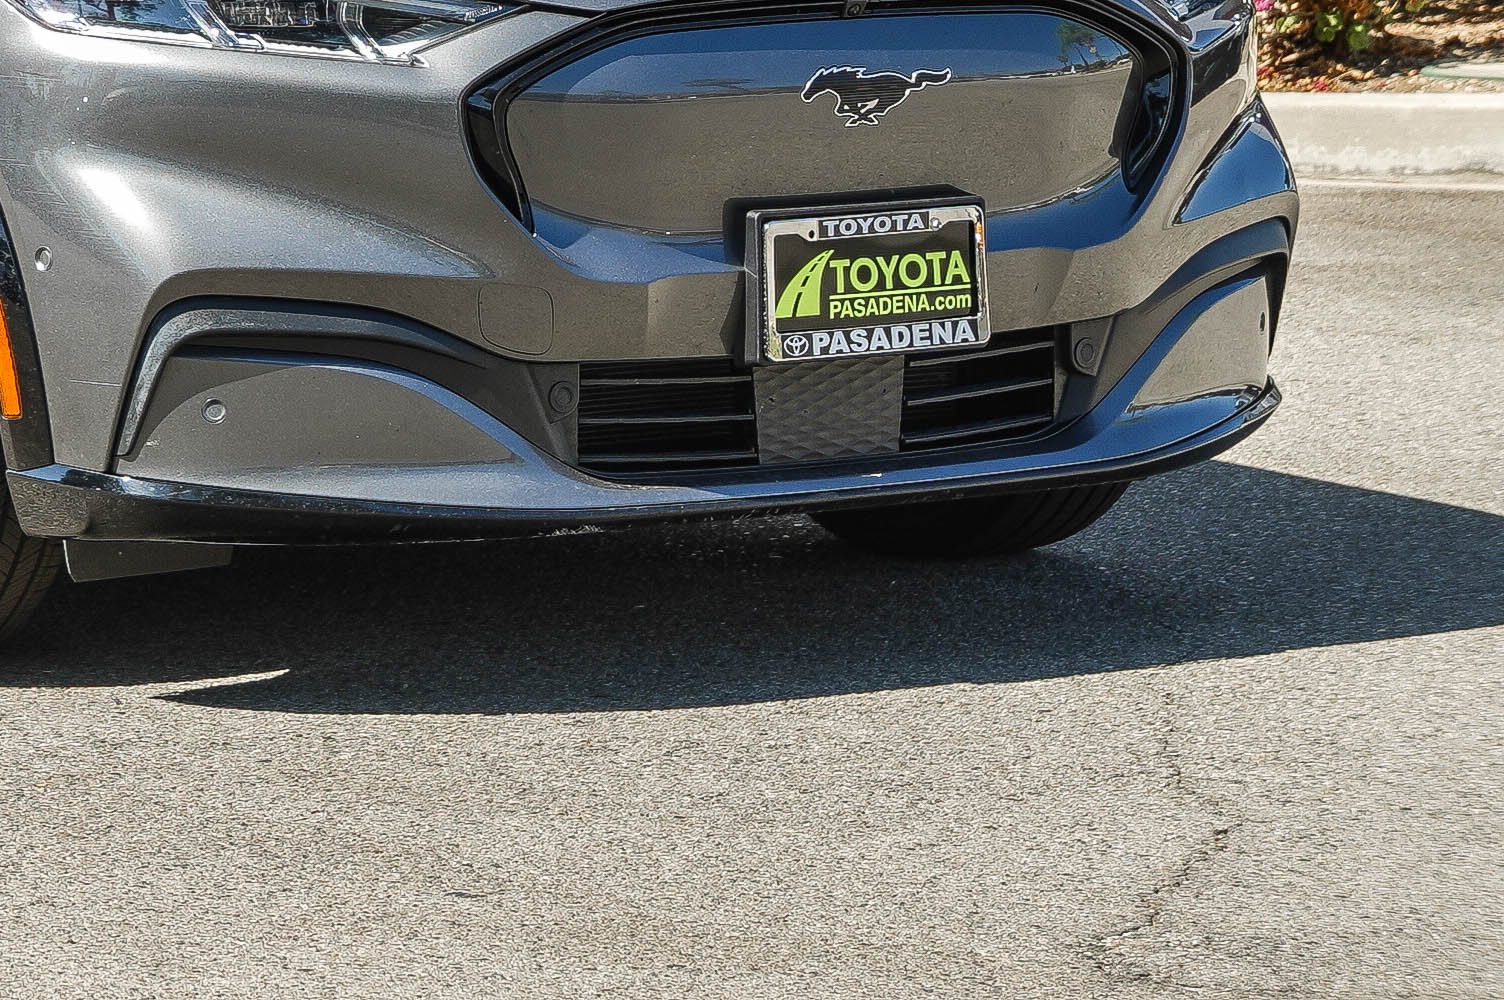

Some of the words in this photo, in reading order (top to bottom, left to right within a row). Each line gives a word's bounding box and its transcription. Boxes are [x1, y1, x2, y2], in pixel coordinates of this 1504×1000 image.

[822, 213, 926, 237] TOYOTA
[829, 250, 971, 293] TOYOTA
[829, 294, 971, 319] PASADENA.com
[812, 320, 976, 356] PASADENA
